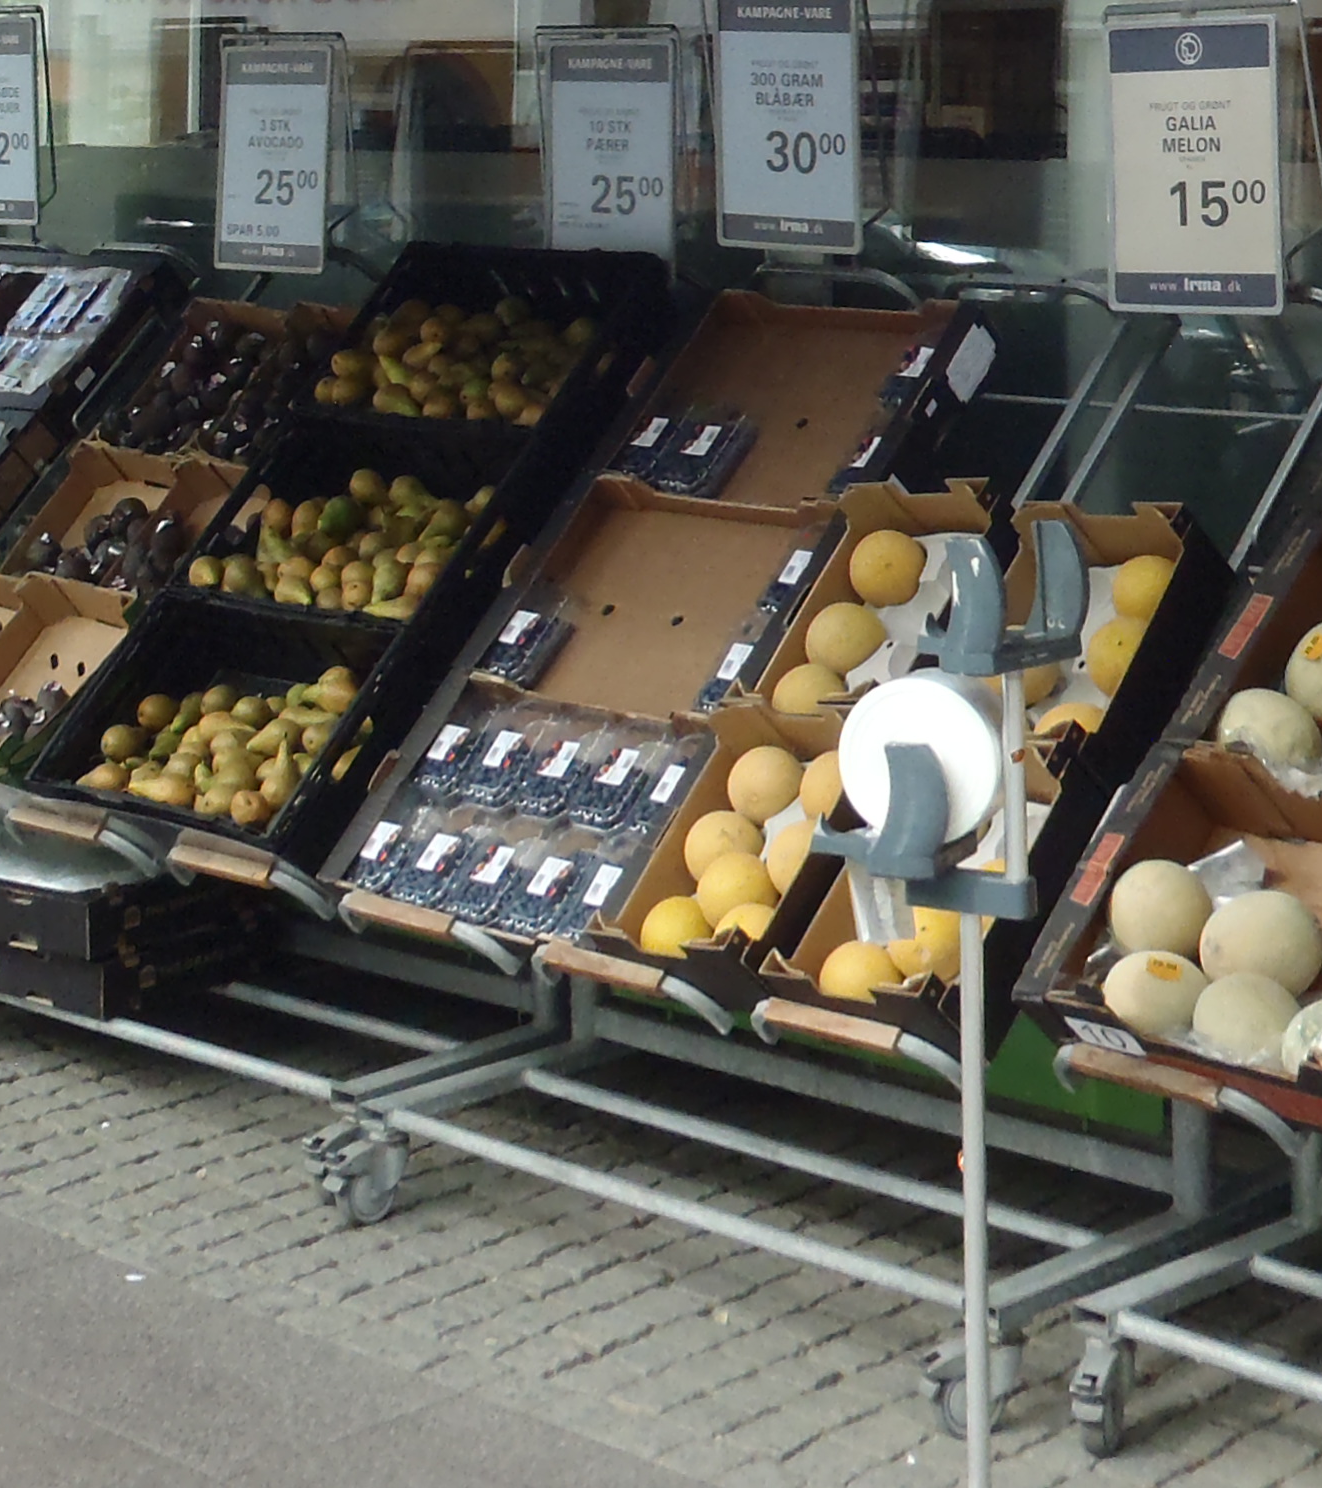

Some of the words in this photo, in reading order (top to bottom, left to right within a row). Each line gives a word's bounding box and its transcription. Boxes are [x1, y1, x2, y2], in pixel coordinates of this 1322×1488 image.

[737, 6, 832, 20] KAMPAGNE-VARE
[750, 72, 776, 86] 300
[781, 73, 823, 88] GRAM
[755, 87, 814, 107] BLÅBÆR
[260, 119, 267, 132] 3
[270, 119, 292, 132] STK
[589, 120, 604, 134] 10
[608, 120, 632, 134] STK
[1165, 115, 1217, 131] GALIA
[248, 136, 304, 149] AVOCADO
[586, 137, 629, 152] PÆRER
[1162, 137, 1221, 153] MELON
[227, 223, 253, 236] SPAR
[1081, 1023, 1127, 1049] 10
